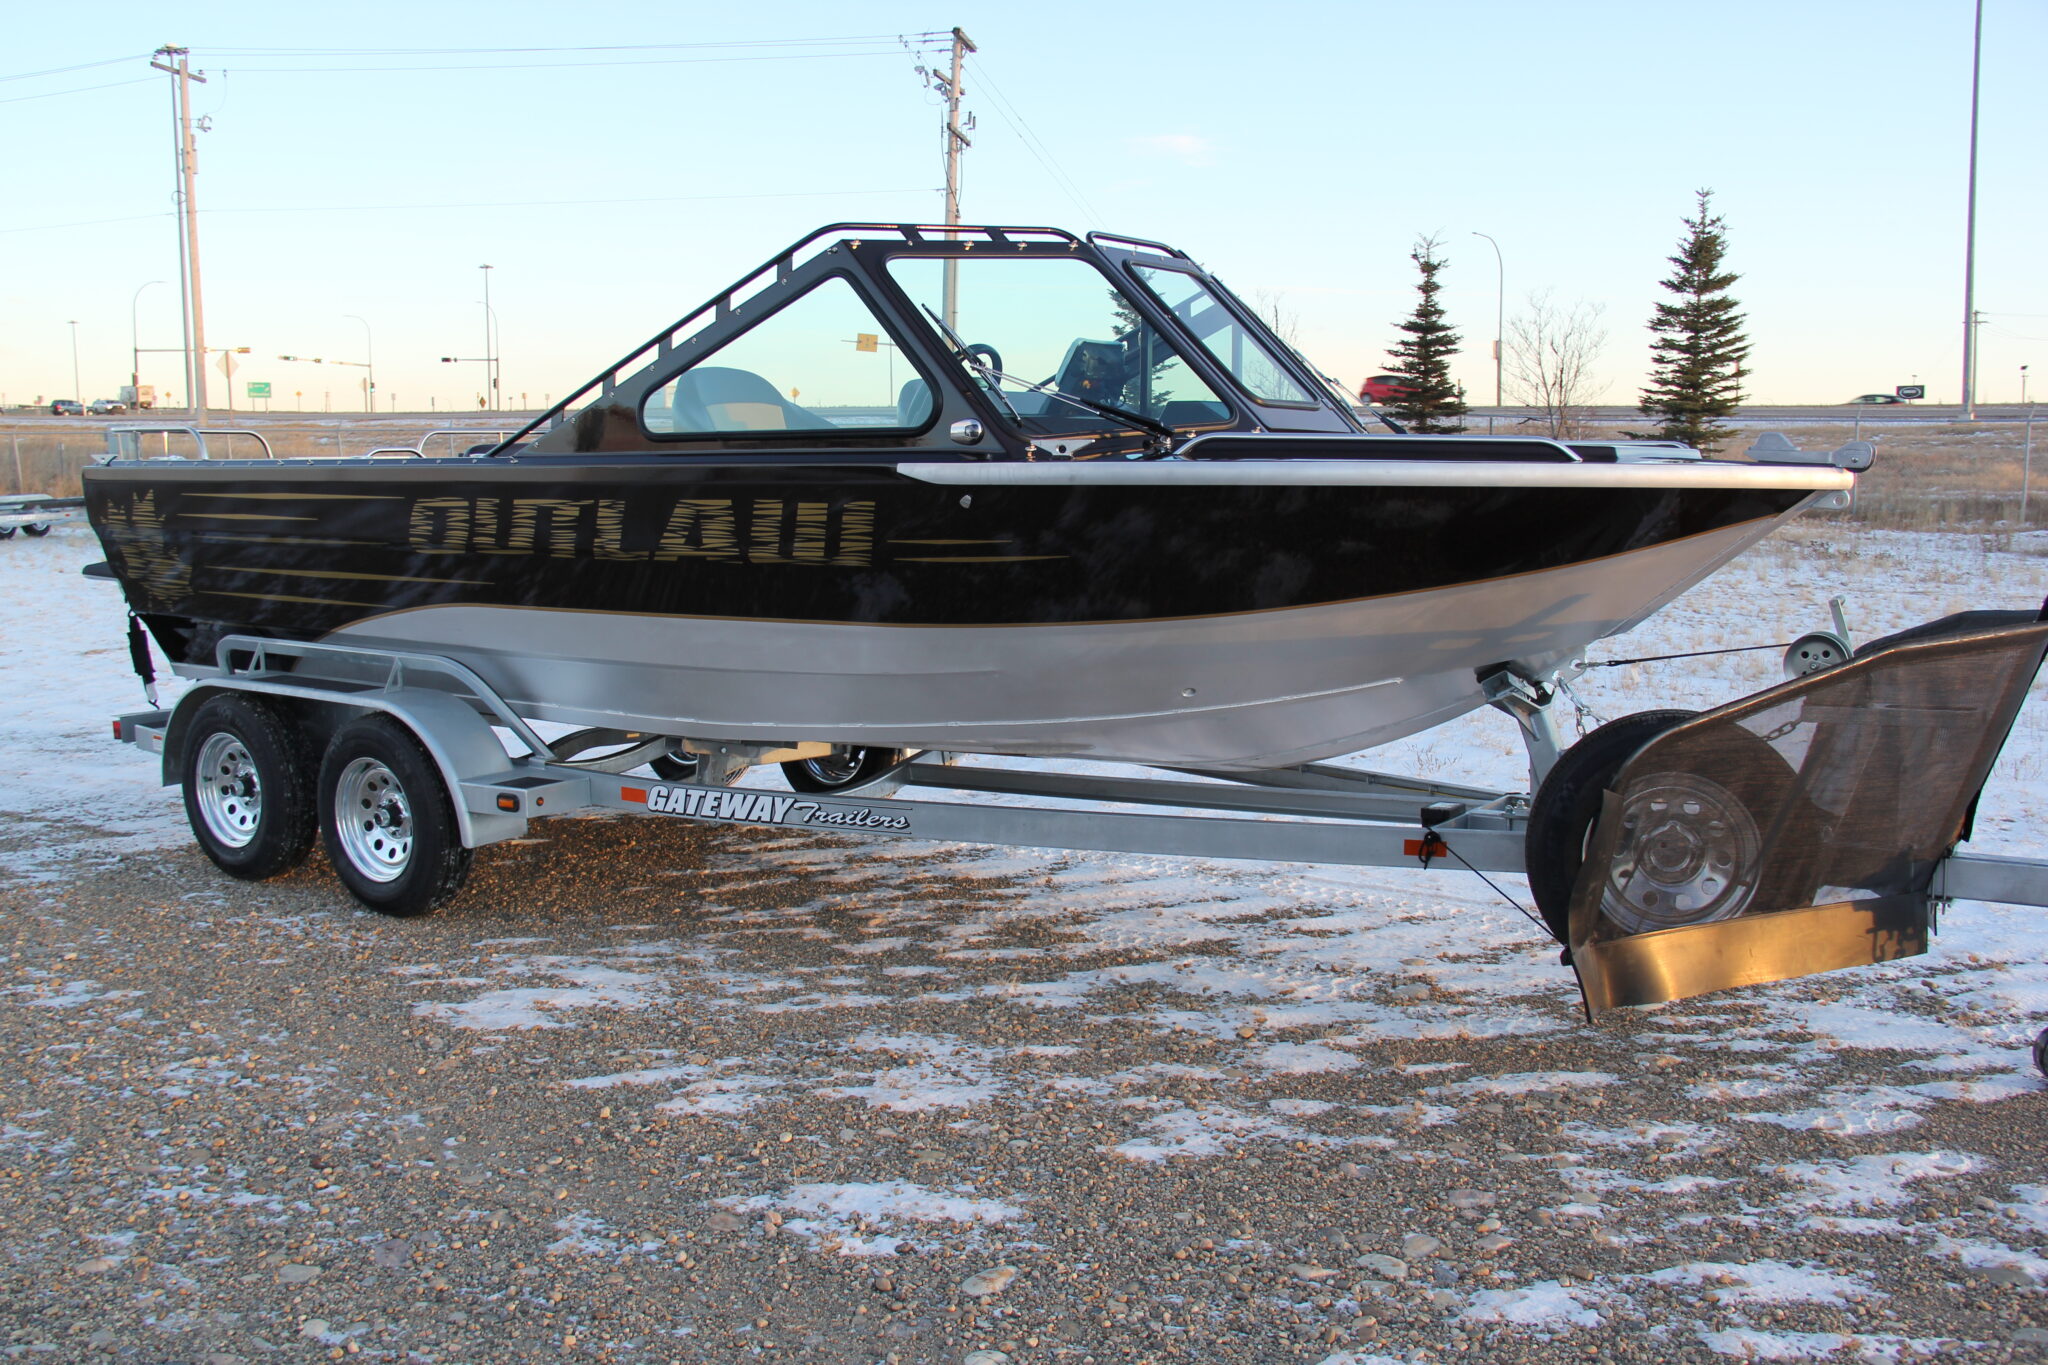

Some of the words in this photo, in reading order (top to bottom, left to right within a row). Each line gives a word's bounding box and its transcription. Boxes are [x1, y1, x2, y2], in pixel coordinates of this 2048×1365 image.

[408, 497, 876, 566] OUTLAW
[646, 785, 795, 824] GATEWAY
[794, 803, 911, 829] Trailers
